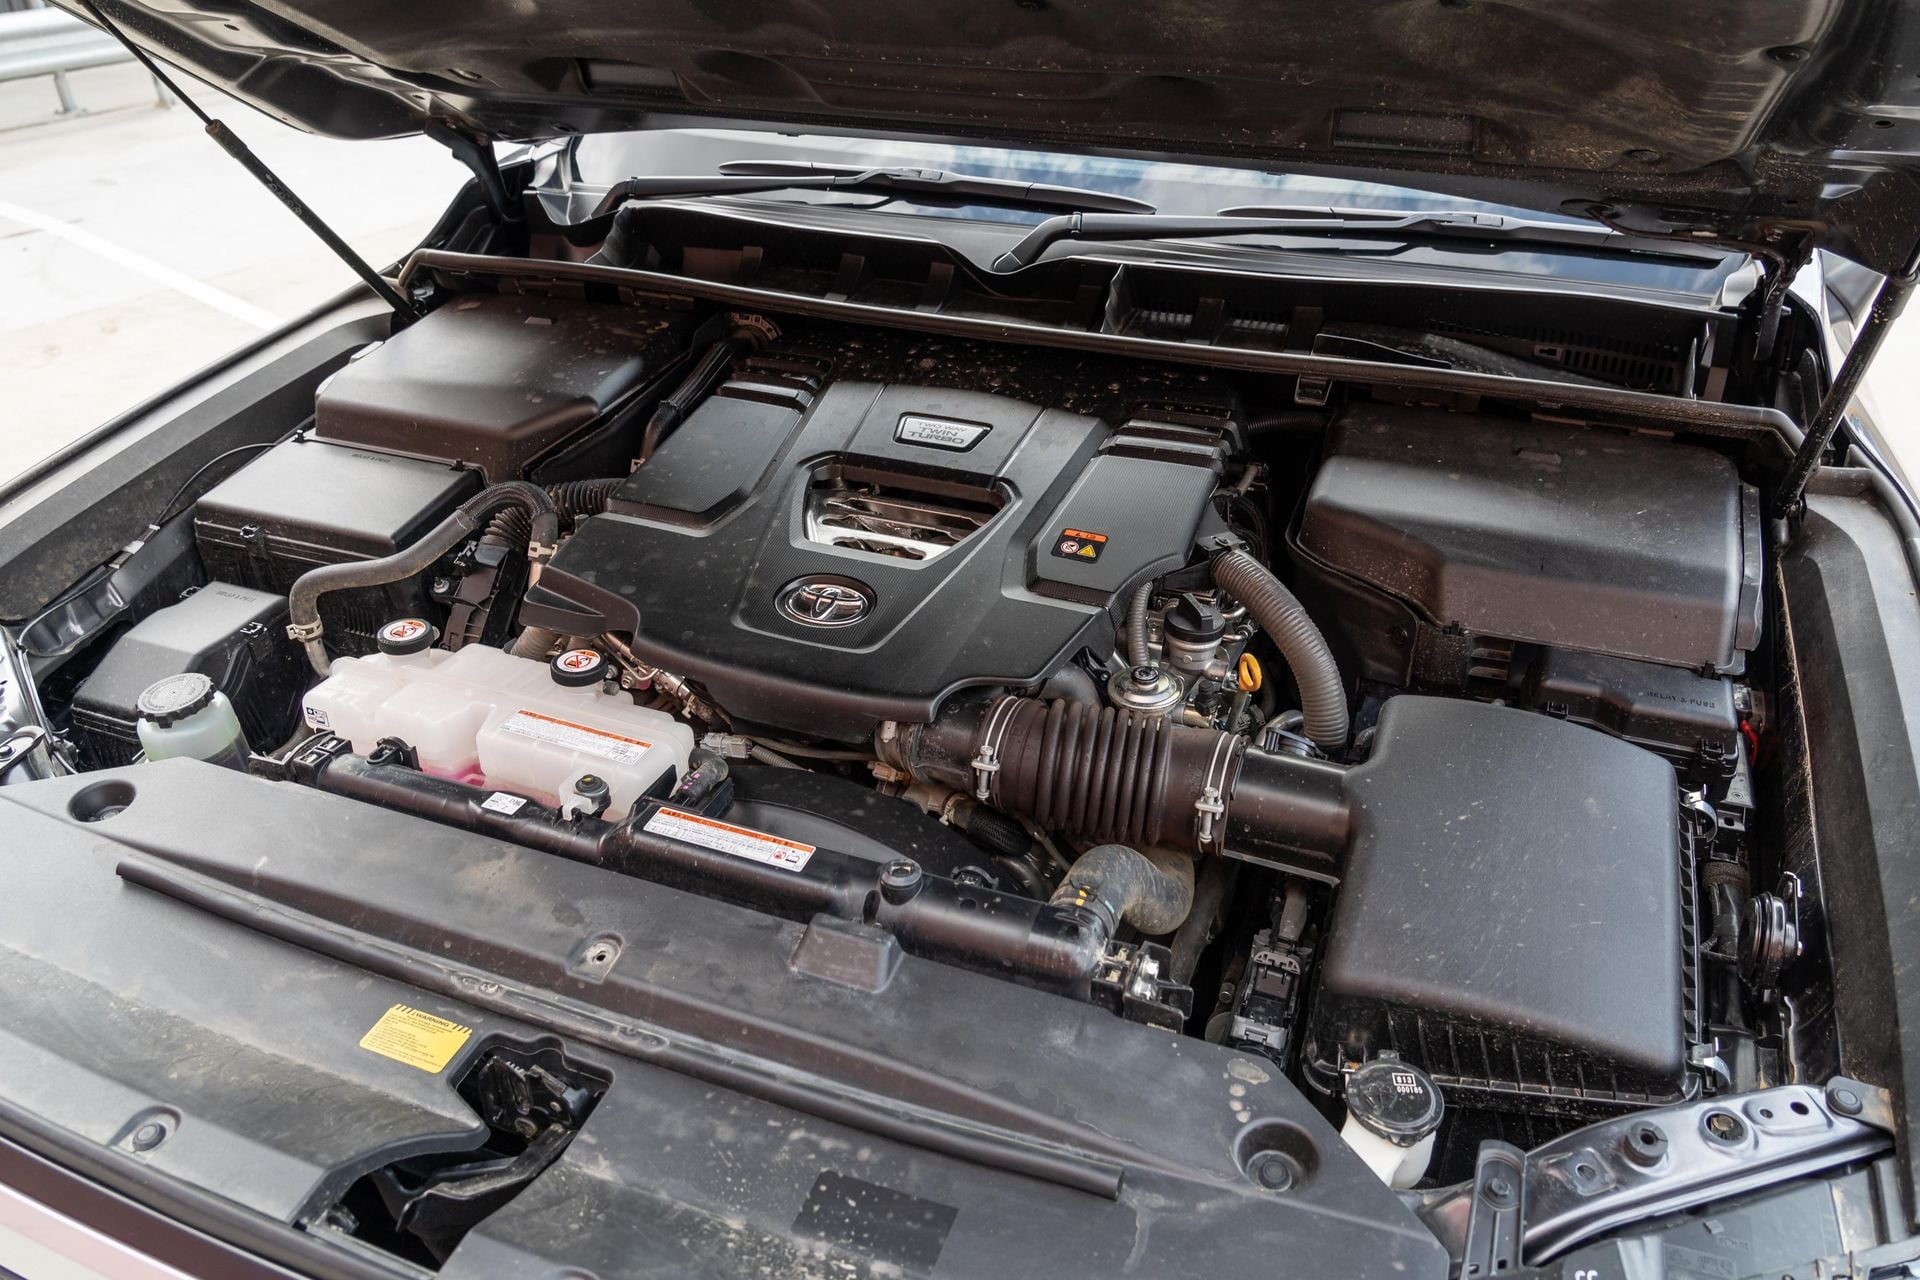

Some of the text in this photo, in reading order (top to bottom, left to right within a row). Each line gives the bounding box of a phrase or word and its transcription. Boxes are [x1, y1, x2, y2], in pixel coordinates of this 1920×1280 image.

[917, 421, 942, 429] TWO
[908, 430, 965, 444] TURBO
[919, 426, 958, 437] TWIN
[416, 1012, 450, 1028] WARNING
